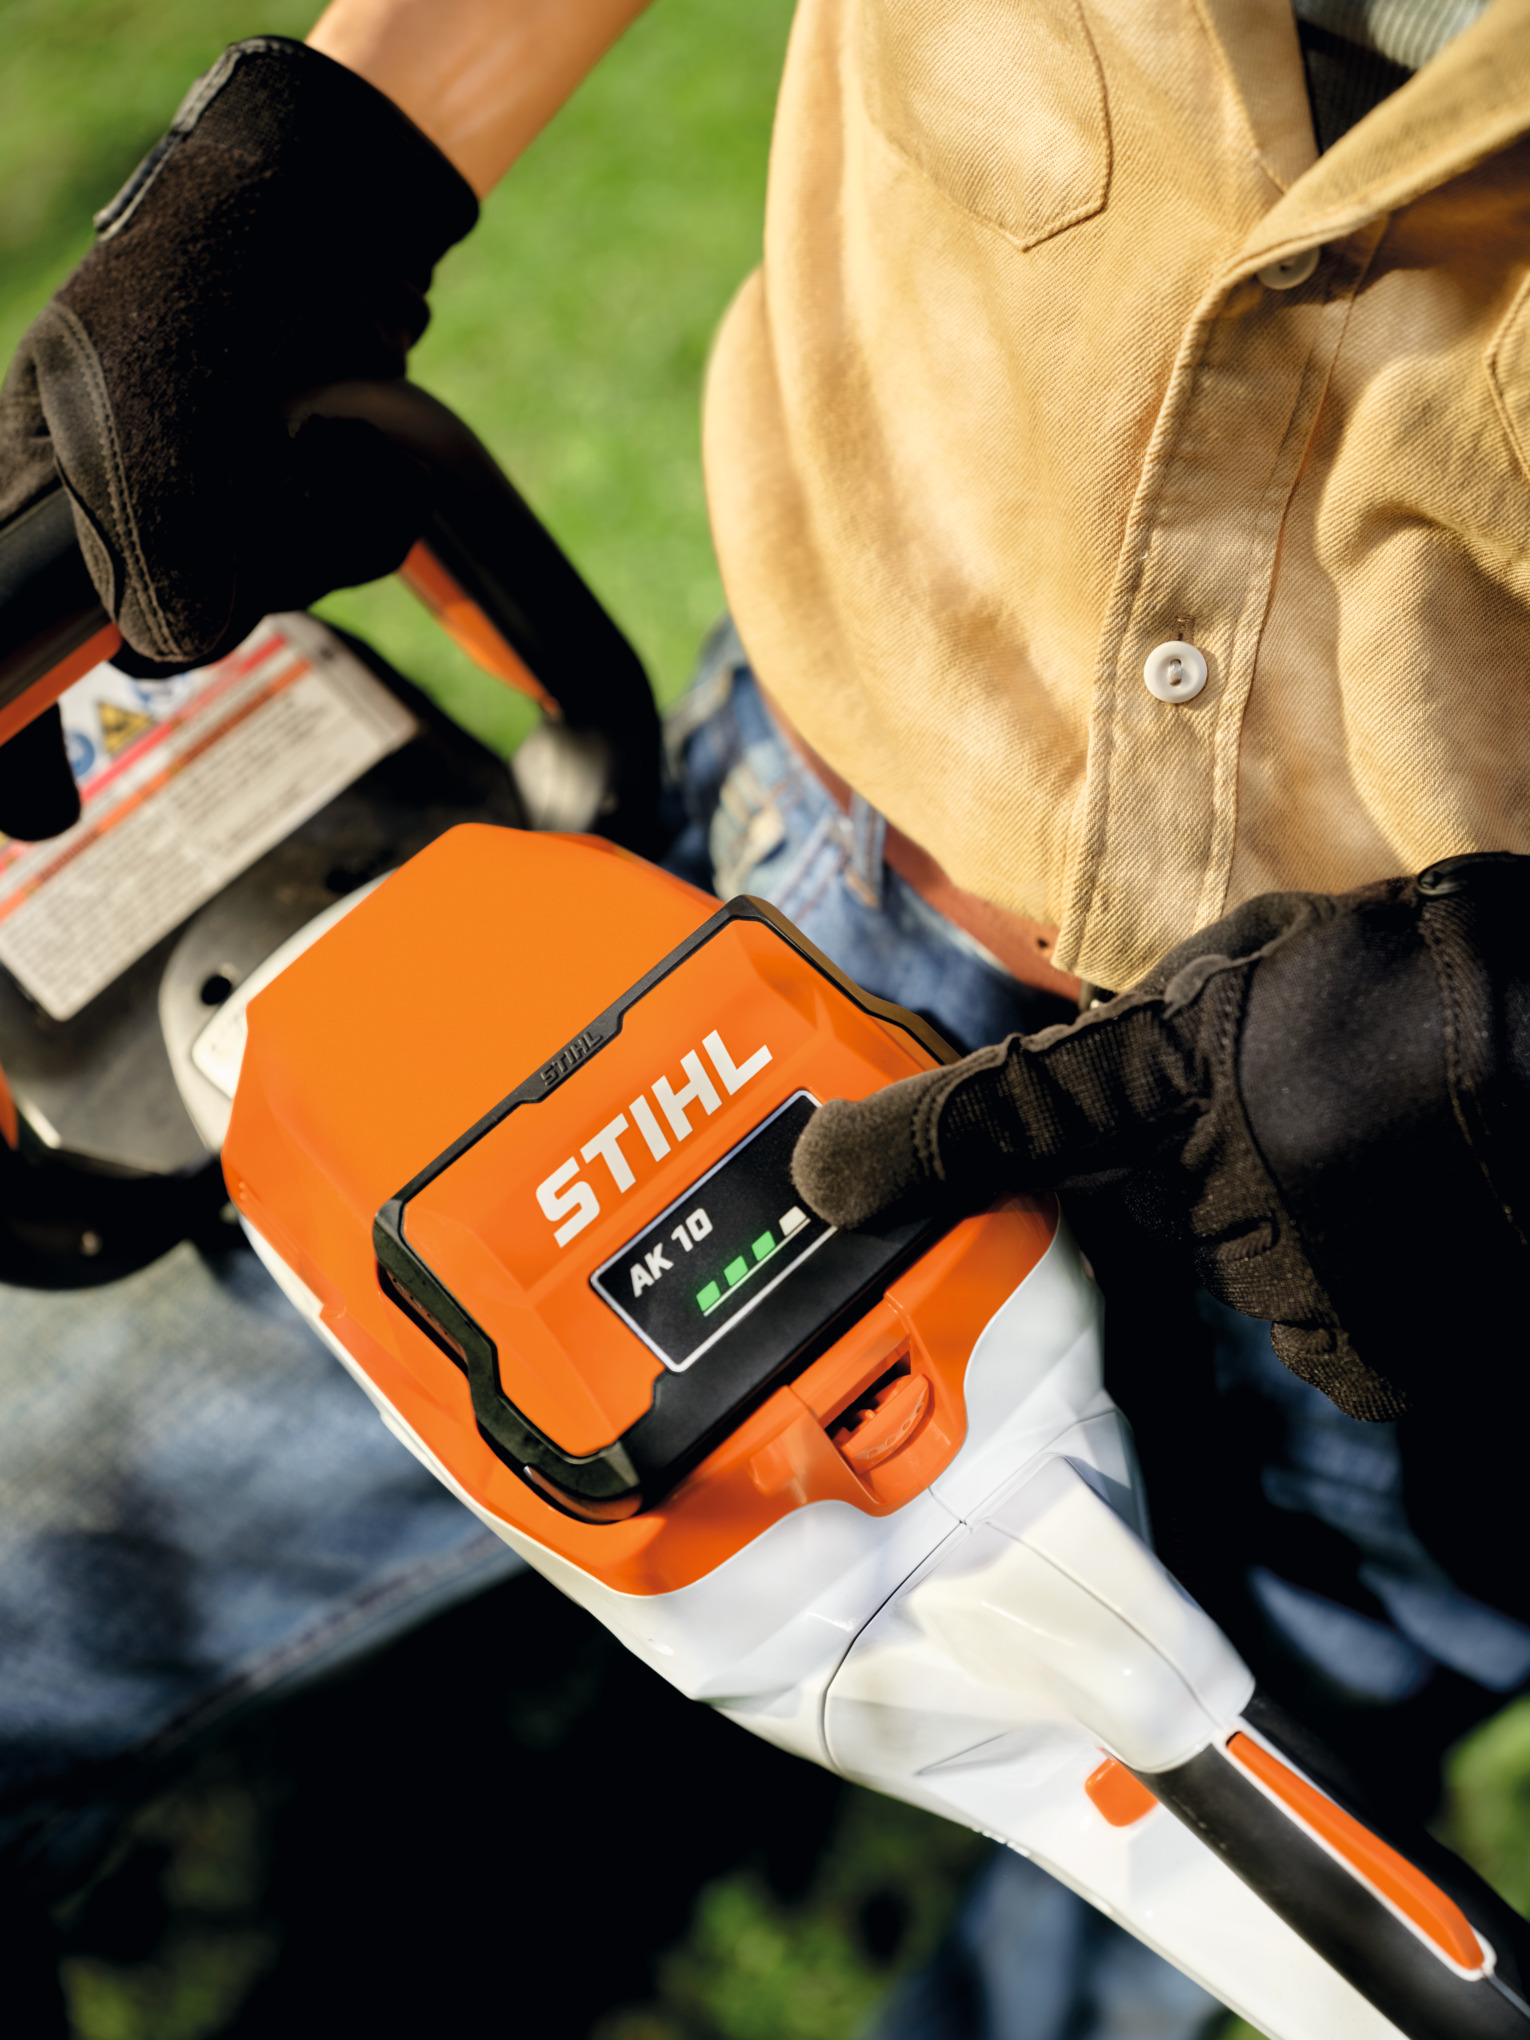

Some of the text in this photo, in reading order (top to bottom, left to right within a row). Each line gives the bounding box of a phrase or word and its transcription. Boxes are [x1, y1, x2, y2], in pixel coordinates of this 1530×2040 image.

[540, 1031, 604, 1086] STIHL
[536, 1030, 773, 1248] STIHL
[629, 1208, 713, 1298] AK 10
